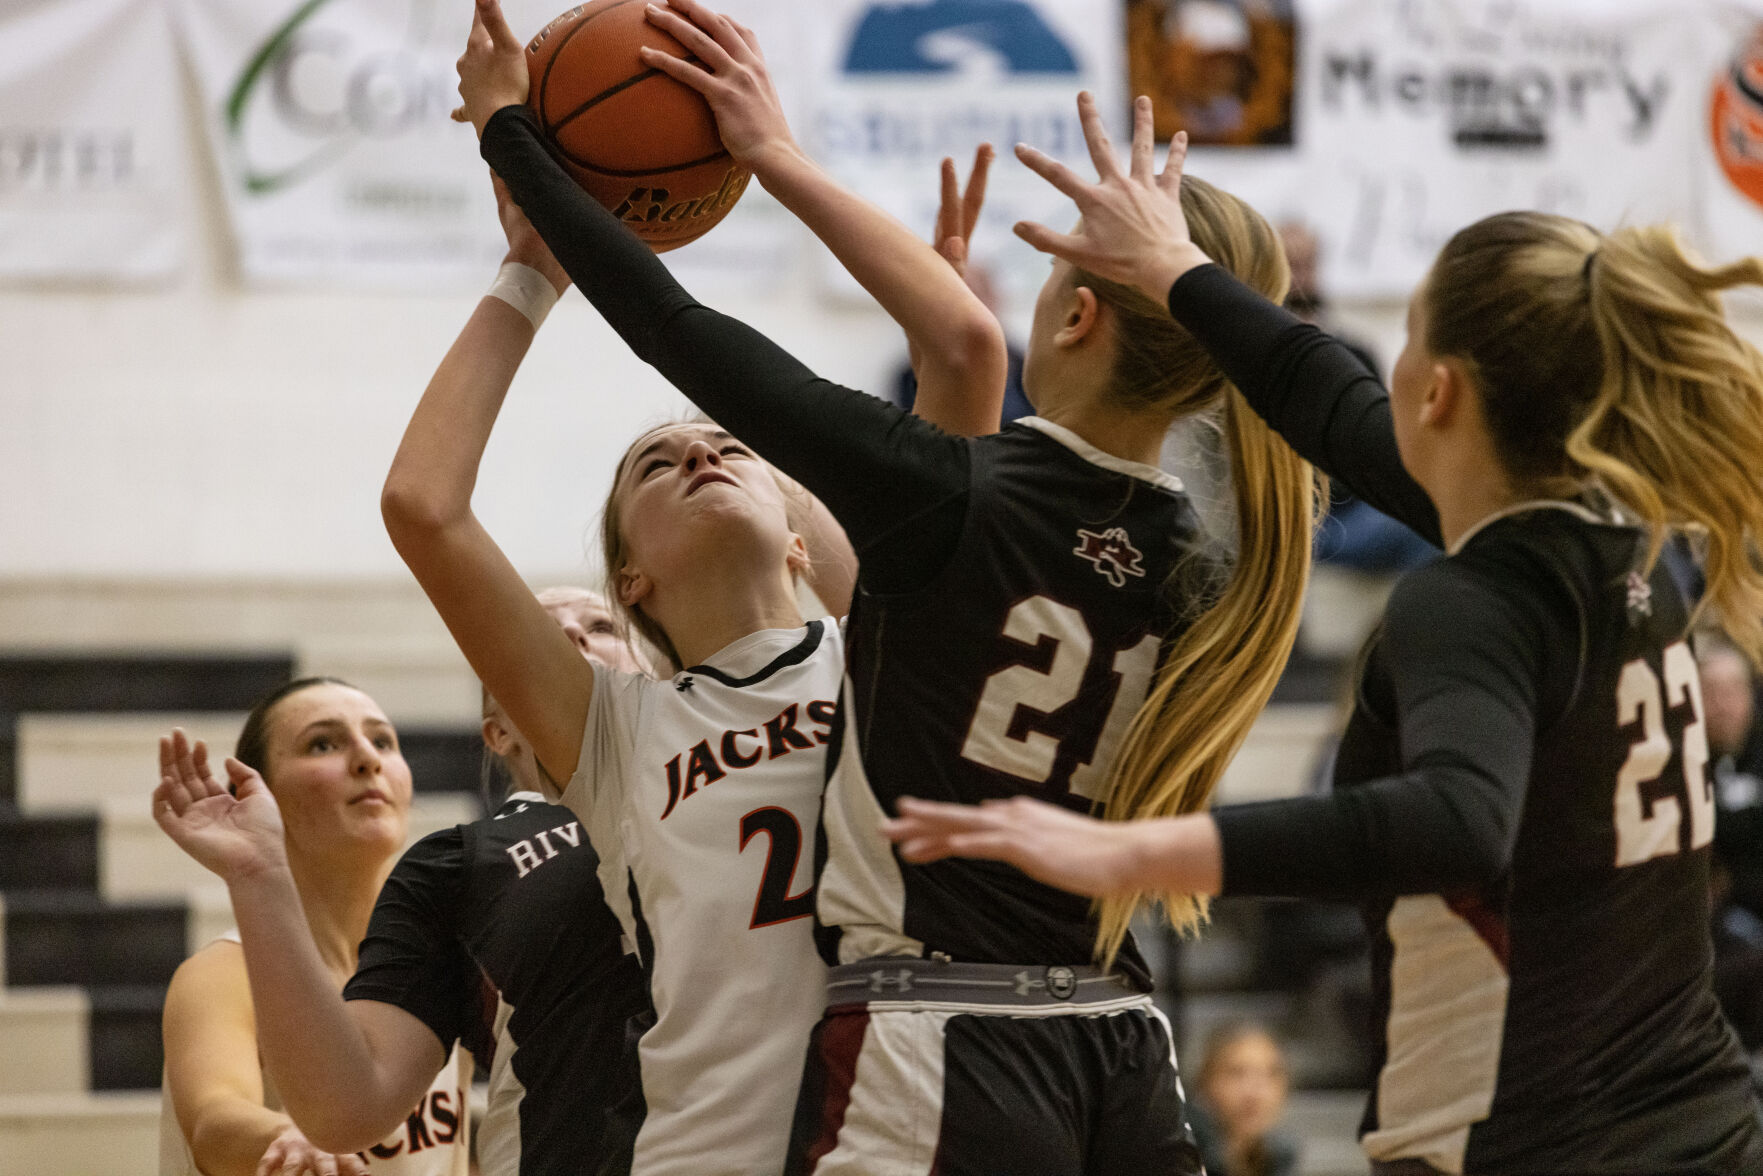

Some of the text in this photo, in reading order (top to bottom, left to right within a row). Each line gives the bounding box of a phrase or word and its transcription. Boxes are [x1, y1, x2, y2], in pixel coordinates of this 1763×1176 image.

[660, 699, 837, 822] JACKS
[959, 594, 1164, 804] 21
[1613, 639, 1717, 868] 22
[505, 820, 582, 879] RIV
[738, 804, 816, 930] 2
